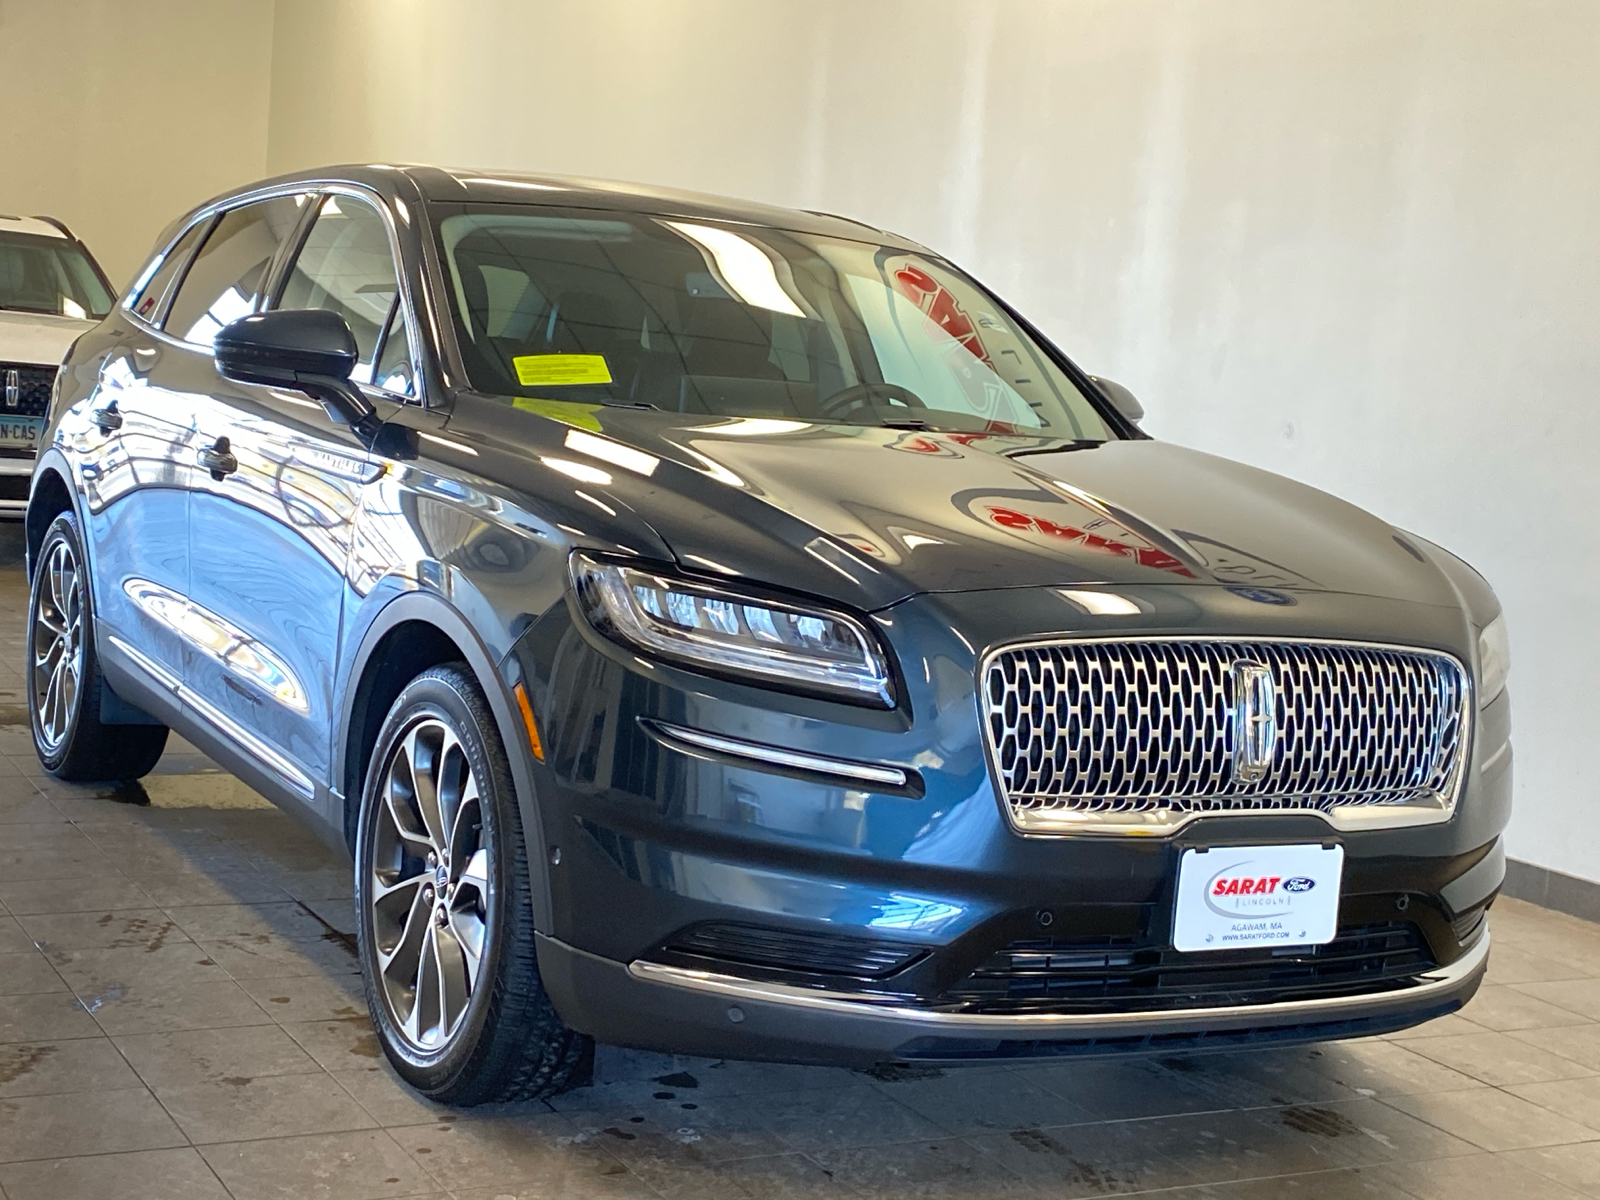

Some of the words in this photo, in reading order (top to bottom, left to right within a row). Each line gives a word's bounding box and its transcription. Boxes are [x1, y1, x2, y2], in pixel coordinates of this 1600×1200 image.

[1212, 877, 1281, 896] SARAT
[1285, 878, 1313, 892] Ford
[1242, 897, 1284, 906] LINCOLN
[1231, 922, 1268, 932] AGAWAM,
[1270, 921, 1283, 931] MA
[1222, 931, 1290, 941] WWW.SARATFORD.COM
